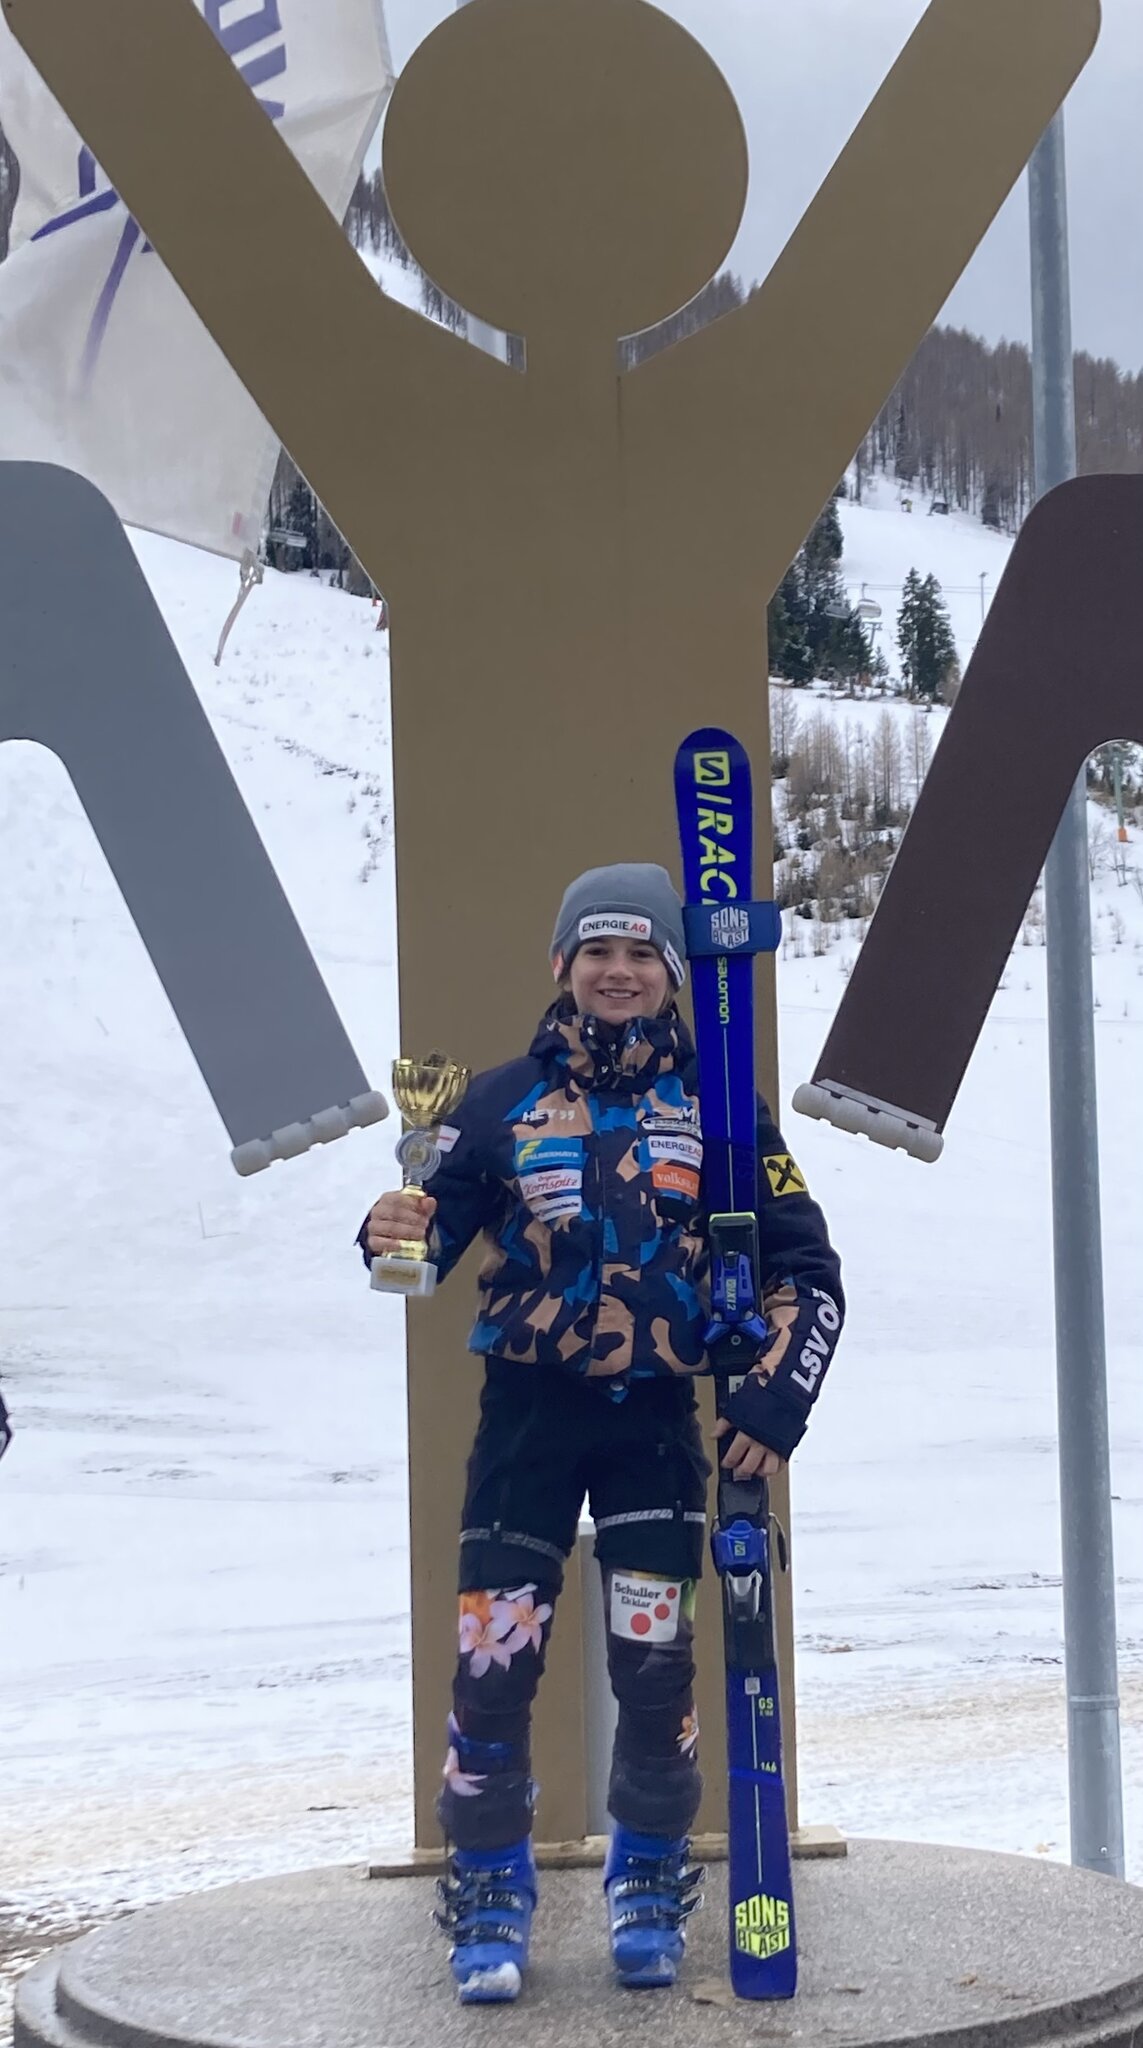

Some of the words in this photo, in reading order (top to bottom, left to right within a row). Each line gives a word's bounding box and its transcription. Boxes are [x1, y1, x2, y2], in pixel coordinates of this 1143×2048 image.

[711, 906, 748, 929] SONS
[716, 956, 729, 1025] salomon
[790, 1325, 830, 1393] LSV
[614, 1582, 661, 1599] Schuller
[758, 1697, 774, 1709] GS
[735, 1893, 788, 1928] SONS
[737, 1928, 790, 1960] BLAST
